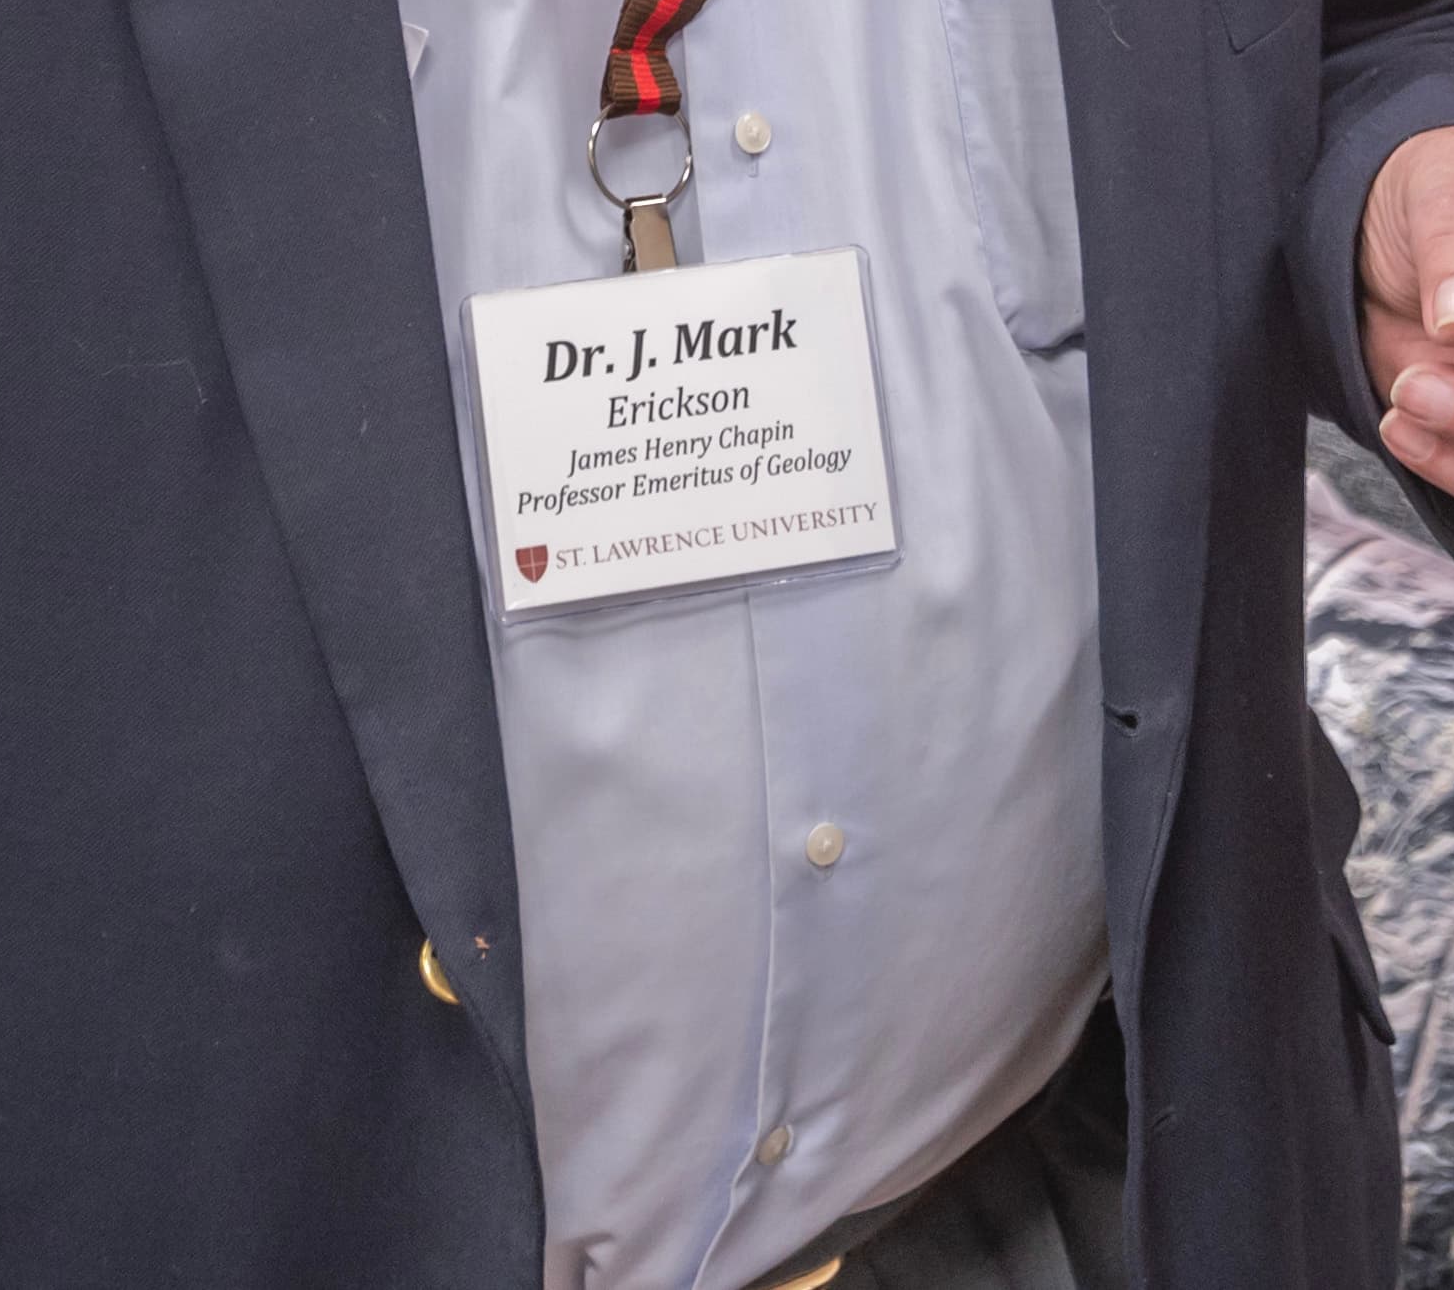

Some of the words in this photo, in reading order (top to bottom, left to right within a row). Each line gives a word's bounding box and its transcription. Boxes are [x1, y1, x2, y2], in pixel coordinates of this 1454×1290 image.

[542, 339, 616, 384] Dr.
[626, 328, 659, 382] J.
[673, 308, 798, 365] Mark
[606, 384, 751, 430] Erickson
[517, 477, 626, 515] Professor
[632, 461, 734, 498] Emeritus
[739, 457, 766, 485] of
[766, 445, 853, 479] Geology
[566, 446, 638, 478] James
[644, 432, 714, 461] Henry
[718, 420, 795, 451] Chapin
[554, 548, 588, 570] ST.
[592, 524, 726, 566] LAWRENCE
[731, 501, 879, 543] UNIVERSITY
